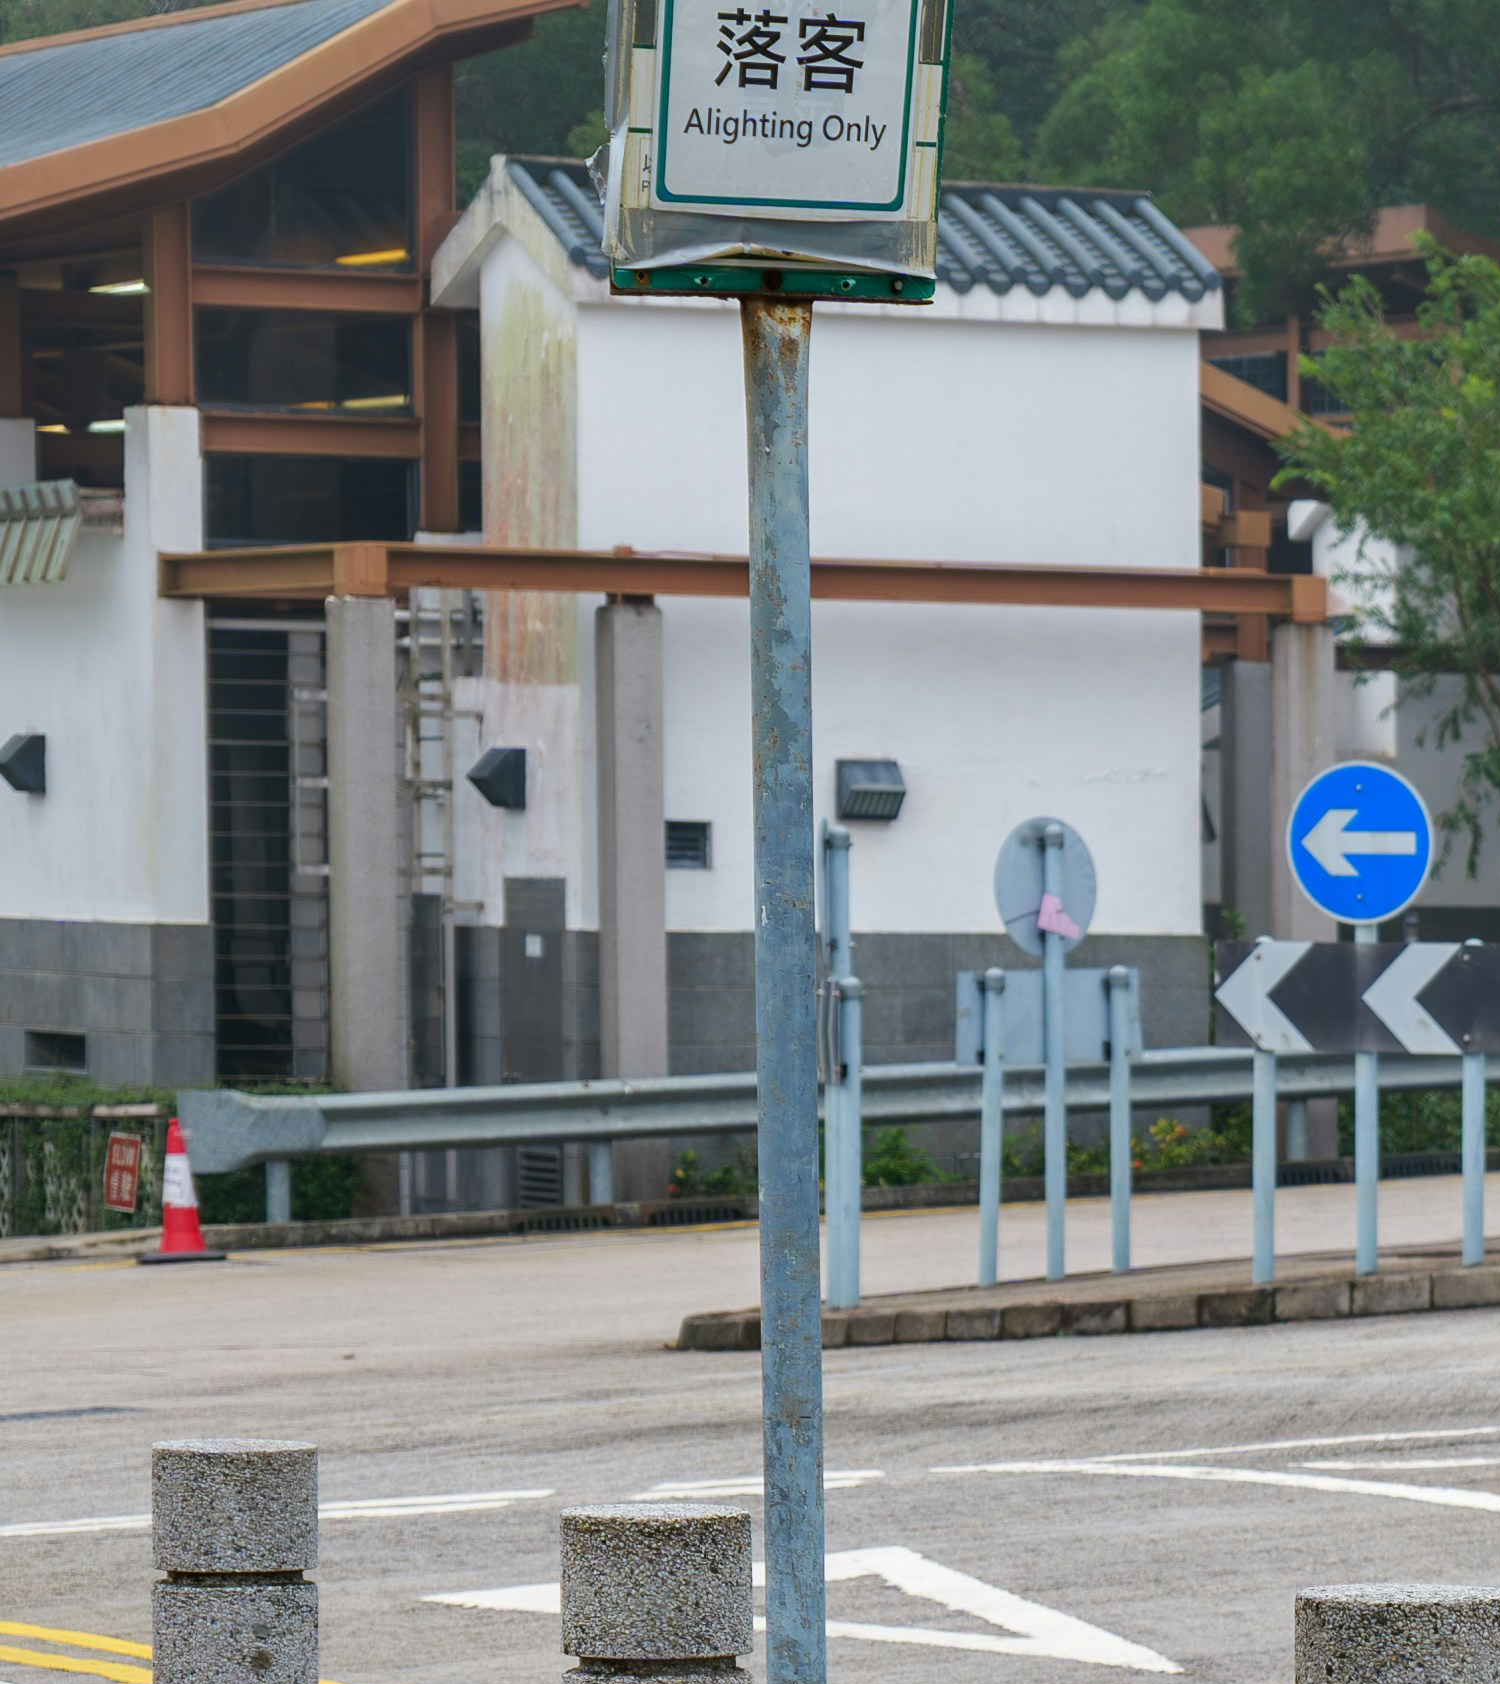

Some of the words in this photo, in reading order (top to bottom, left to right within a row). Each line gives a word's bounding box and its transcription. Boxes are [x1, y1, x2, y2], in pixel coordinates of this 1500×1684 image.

[714, 8, 865, 93] 落客
[684, 108, 812, 147] Alighting
[822, 115, 886, 150] Only
